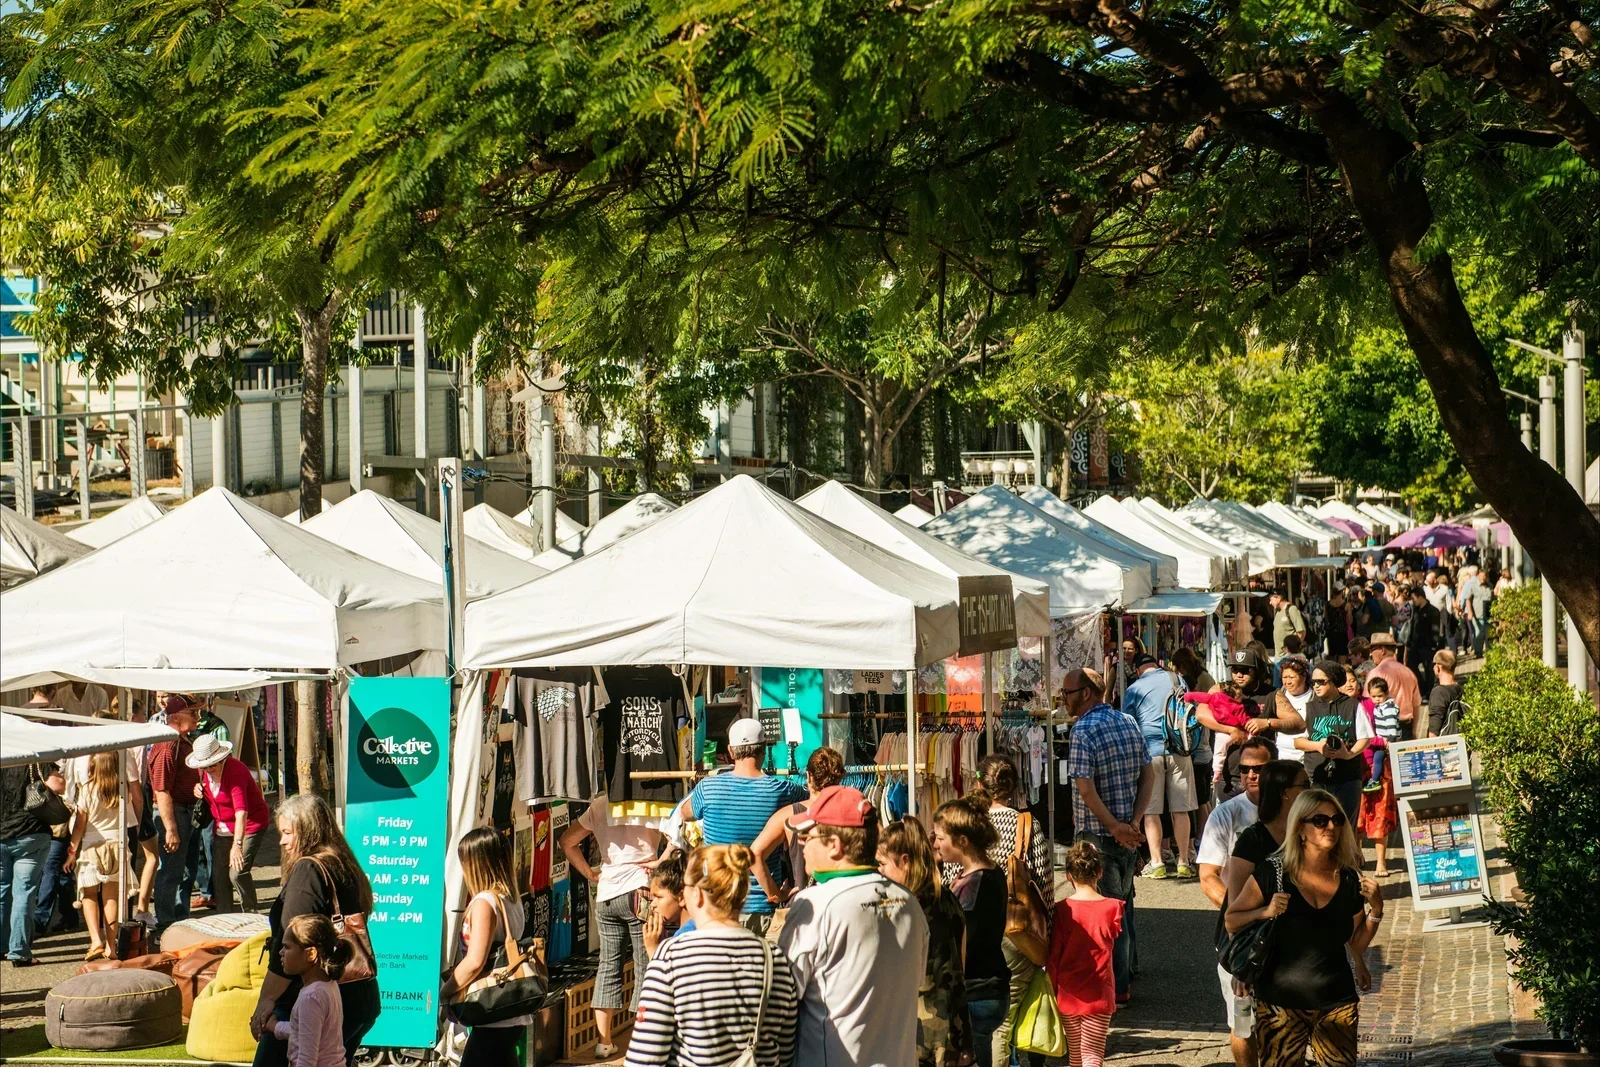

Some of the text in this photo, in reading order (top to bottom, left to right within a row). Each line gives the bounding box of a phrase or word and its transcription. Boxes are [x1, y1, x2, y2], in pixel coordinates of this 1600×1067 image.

[961, 596, 977, 637] THE
[861, 670, 885, 679] LADIES
[625, 696, 657, 710] SONS
[622, 728, 662, 745] MOTORCYCLE
[363, 735, 432, 755] Collective
[376, 756, 419, 765] MARKETS
[377, 816, 413, 830] Friday
[362, 835, 370, 846] 5
[371, 835, 390, 846] PM
[399, 836, 407, 846] 9
[409, 836, 428, 847] PM
[368, 854, 419, 868] Saturday
[1435, 857, 1458, 869] Live
[372, 873, 392, 884] AM
[401, 874, 409, 884] 9
[411, 874, 430, 885] PM
[1434, 867, 1463, 880] Music
[372, 892, 413, 906] Sunday
[369, 912, 388, 922] AM
[397, 912, 423, 923] 4PM
[401, 953, 429, 961] Markets
[389, 961, 407, 969] Bank
[395, 991, 424, 1001] BANK
